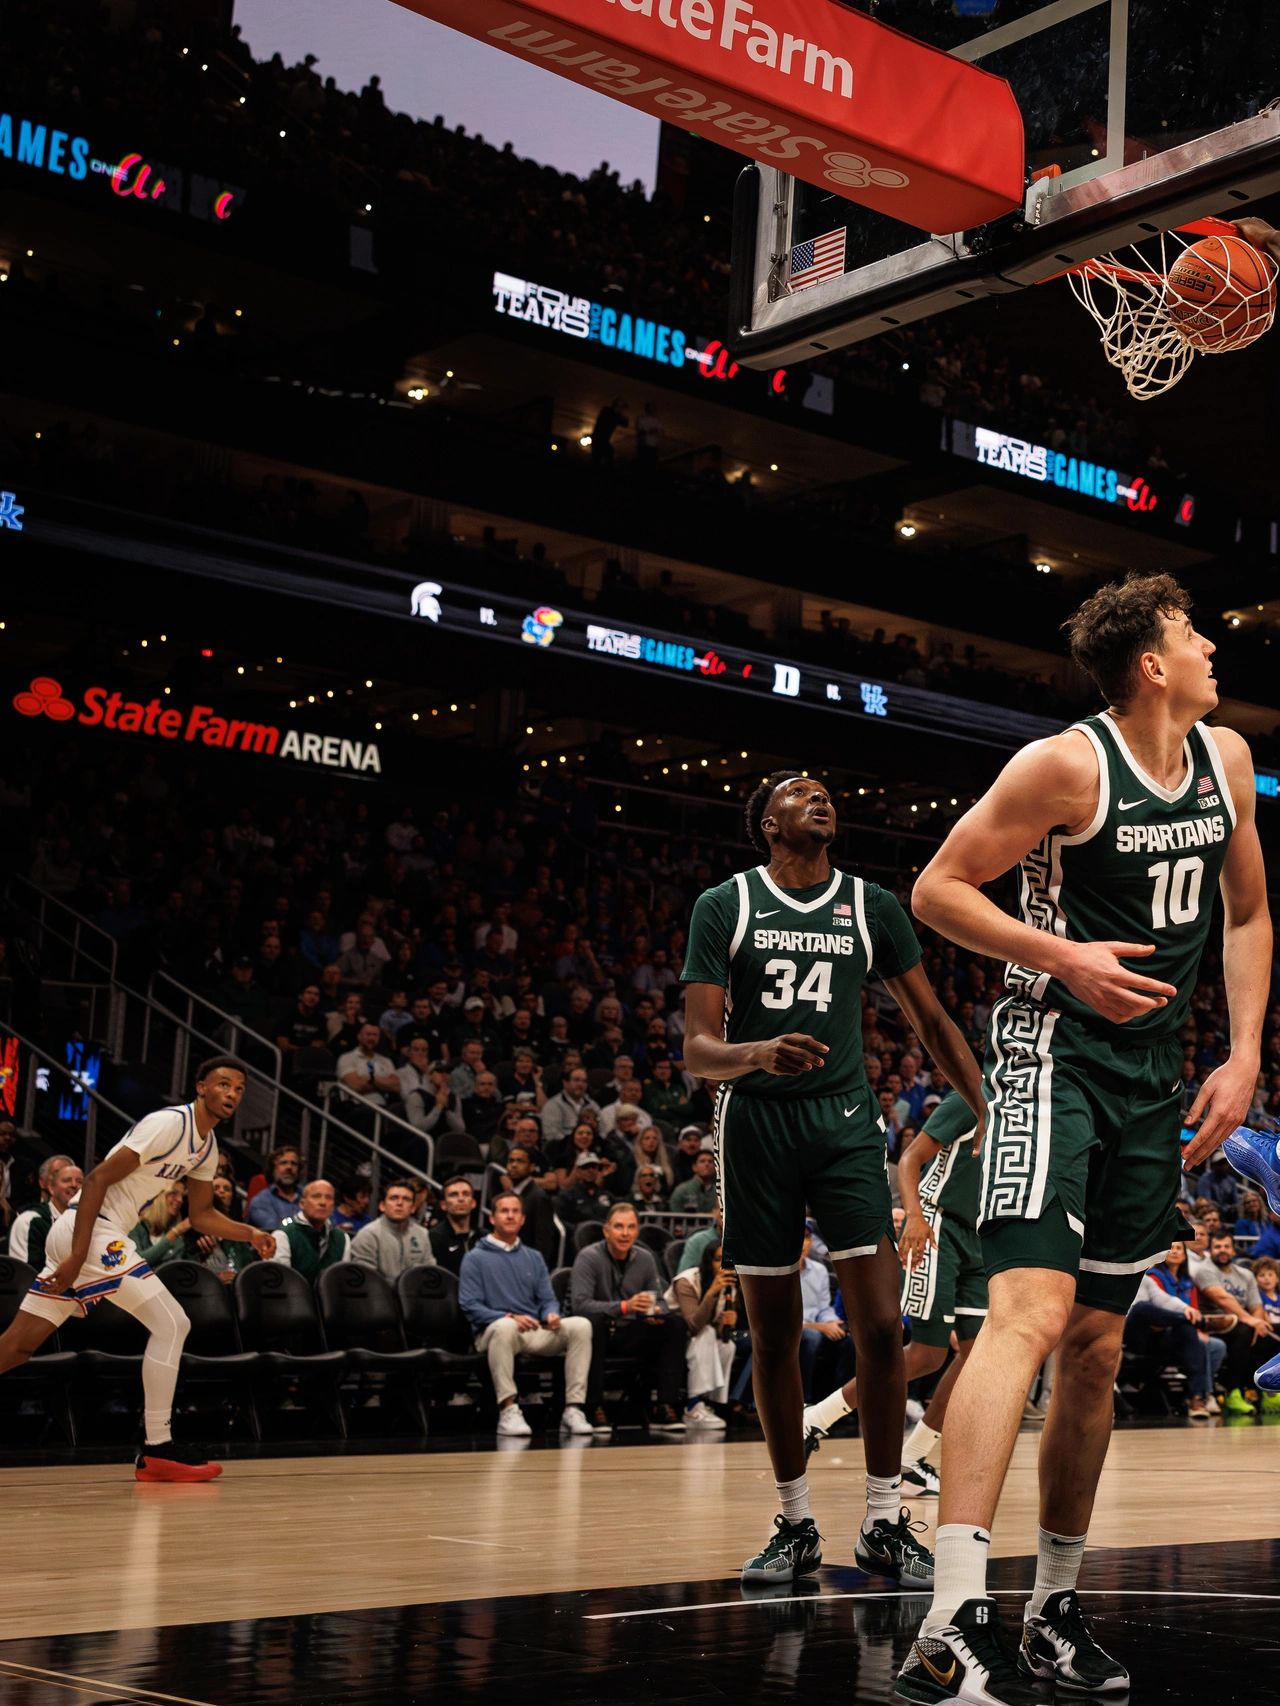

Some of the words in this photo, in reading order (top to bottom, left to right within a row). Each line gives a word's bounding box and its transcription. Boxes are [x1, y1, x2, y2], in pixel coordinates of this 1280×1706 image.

[486, 20, 673, 96] Farm
[719, 0, 854, 99] Farm
[0, 113, 89, 180] AMES
[653, 88, 827, 159] State
[493, 287, 590, 339] TEAMS
[600, 306, 686, 368] GAMES
[975, 441, 1047, 481] TEAMS
[1054, 452, 1117, 503] GAMES
[645, 638, 695, 671] GAMES
[78, 686, 182, 739] State
[184, 705, 280, 754] Farm
[280, 729, 382, 773] ARENA
[1116, 815, 1225, 853] SPARTANS
[1148, 855, 1205, 930] 10
[753, 929, 855, 956] SPARTANS
[761, 958, 833, 1013] 34
